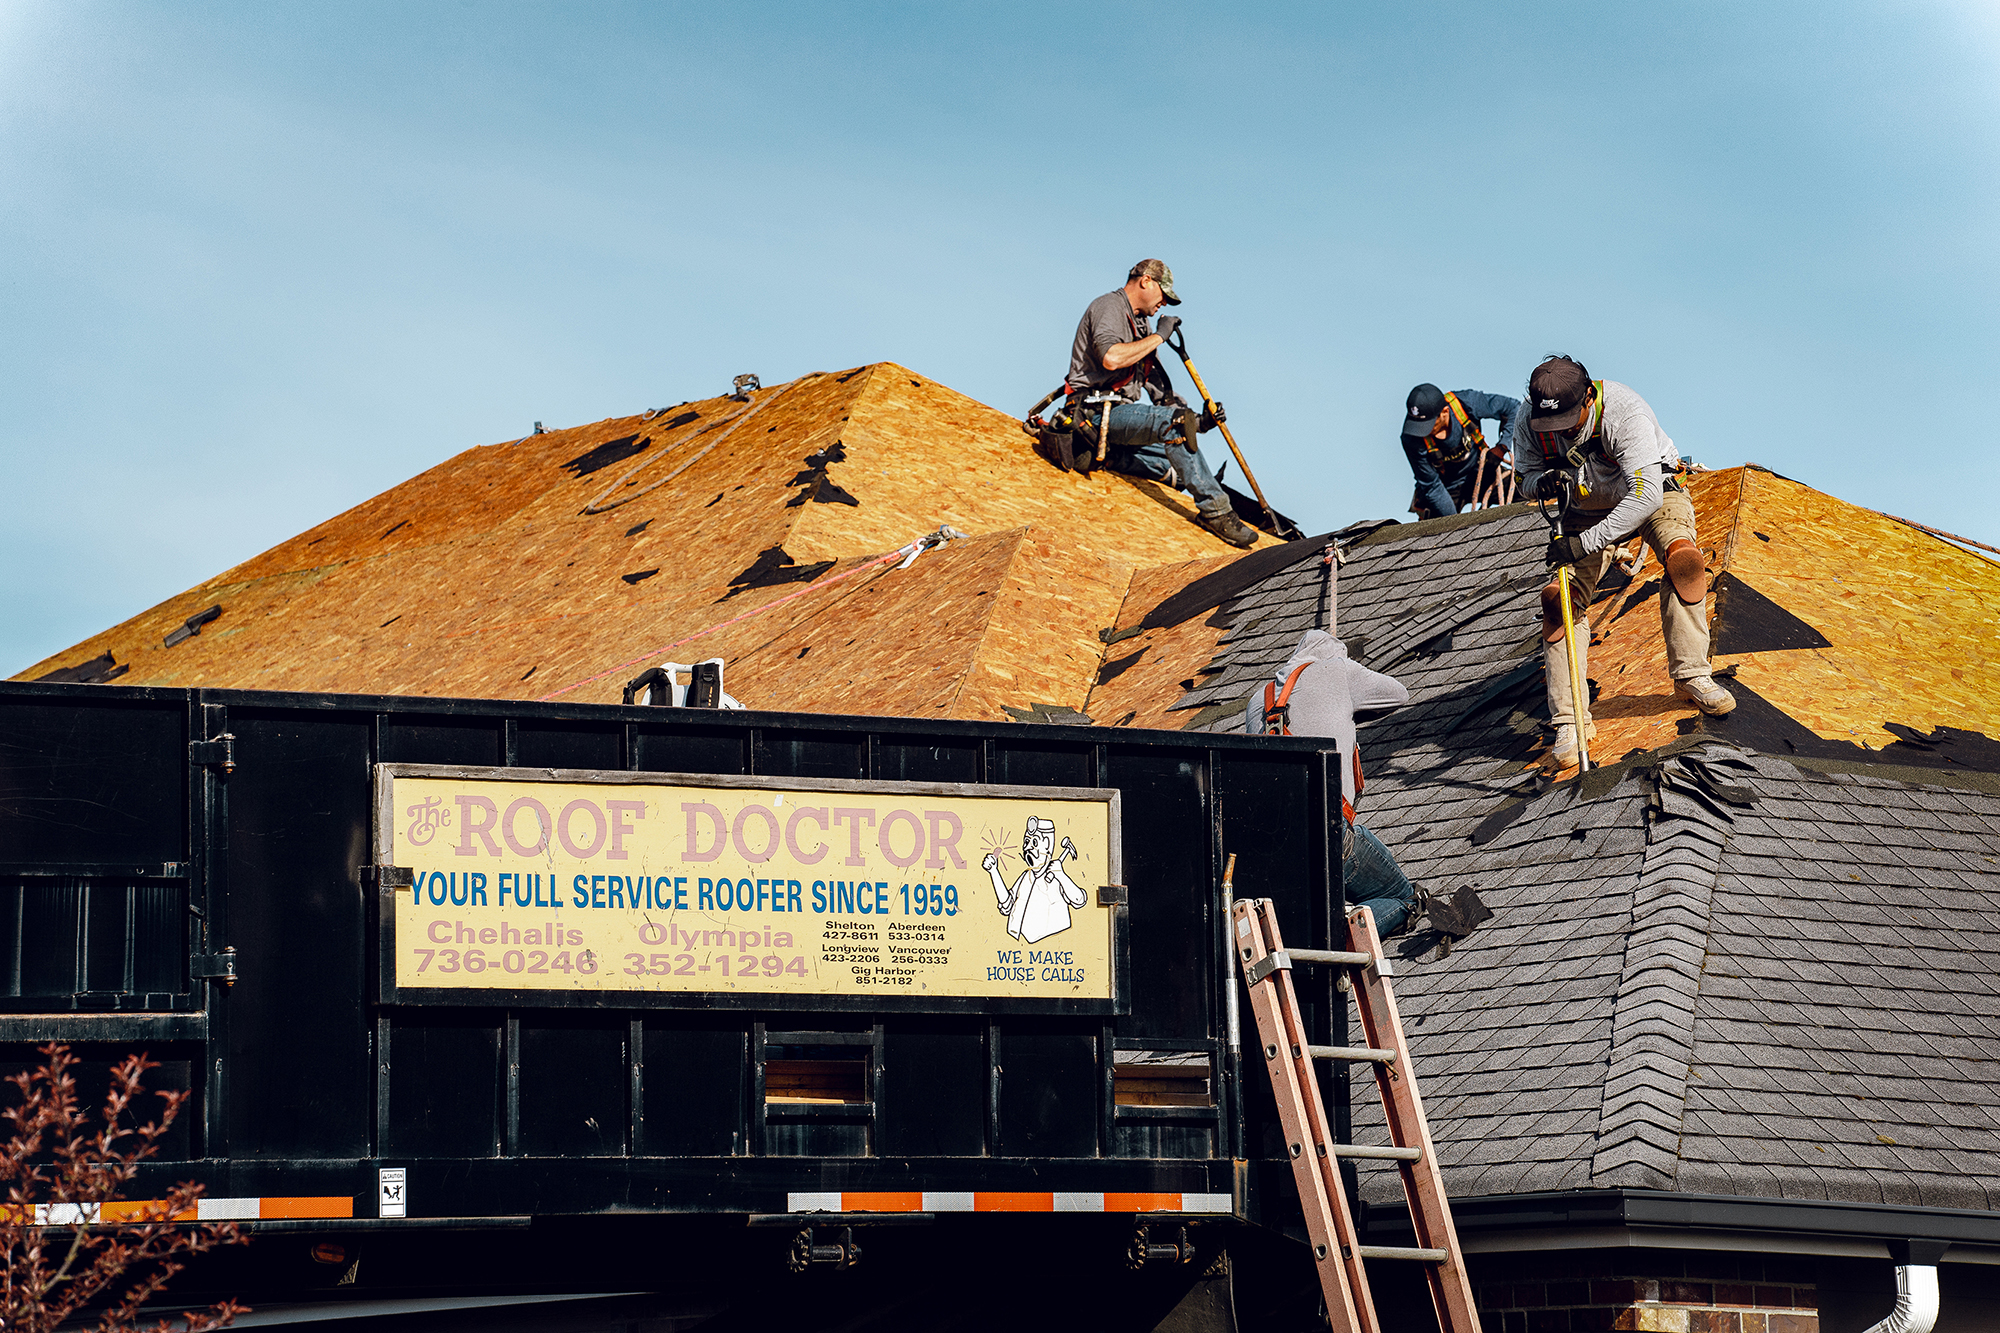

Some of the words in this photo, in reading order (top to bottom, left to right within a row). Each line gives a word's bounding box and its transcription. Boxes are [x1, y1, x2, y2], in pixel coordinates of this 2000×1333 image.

[407, 796, 451, 846] The
[455, 795, 646, 860] ROOF
[681, 802, 967, 870] DOCTOR
[413, 871, 488, 907] YOUR
[499, 873, 564, 908] FULL
[573, 874, 688, 911] SERVICE
[698, 877, 802, 913] ROOFER
[812, 880, 888, 915] SINCE
[900, 884, 959, 917] 1959
[825, 920, 875, 931] Shelton
[888, 922, 946, 932] Aberdeen
[427, 920, 584, 946] Chehalis
[638, 923, 793, 953] Olympia
[822, 931, 879, 941] 427-8611
[888, 932, 945, 941] 533-0314
[822, 944, 879, 955] Longview
[888, 945, 951, 956] Vancouver
[413, 949, 598, 975] 736-0246
[822, 954, 880, 963] 423-2206
[891, 955, 948, 965] 256-0333
[997, 950, 1022, 964] WE
[1029, 951, 1073, 965] MAKE
[623, 953, 809, 978] 352-1294
[851, 966, 871, 976] Gig
[875, 966, 916, 976] Harbor
[986, 966, 1035, 981] HOUSE
[1041, 967, 1085, 982] CALLS
[855, 976, 913, 985] 851-2182
